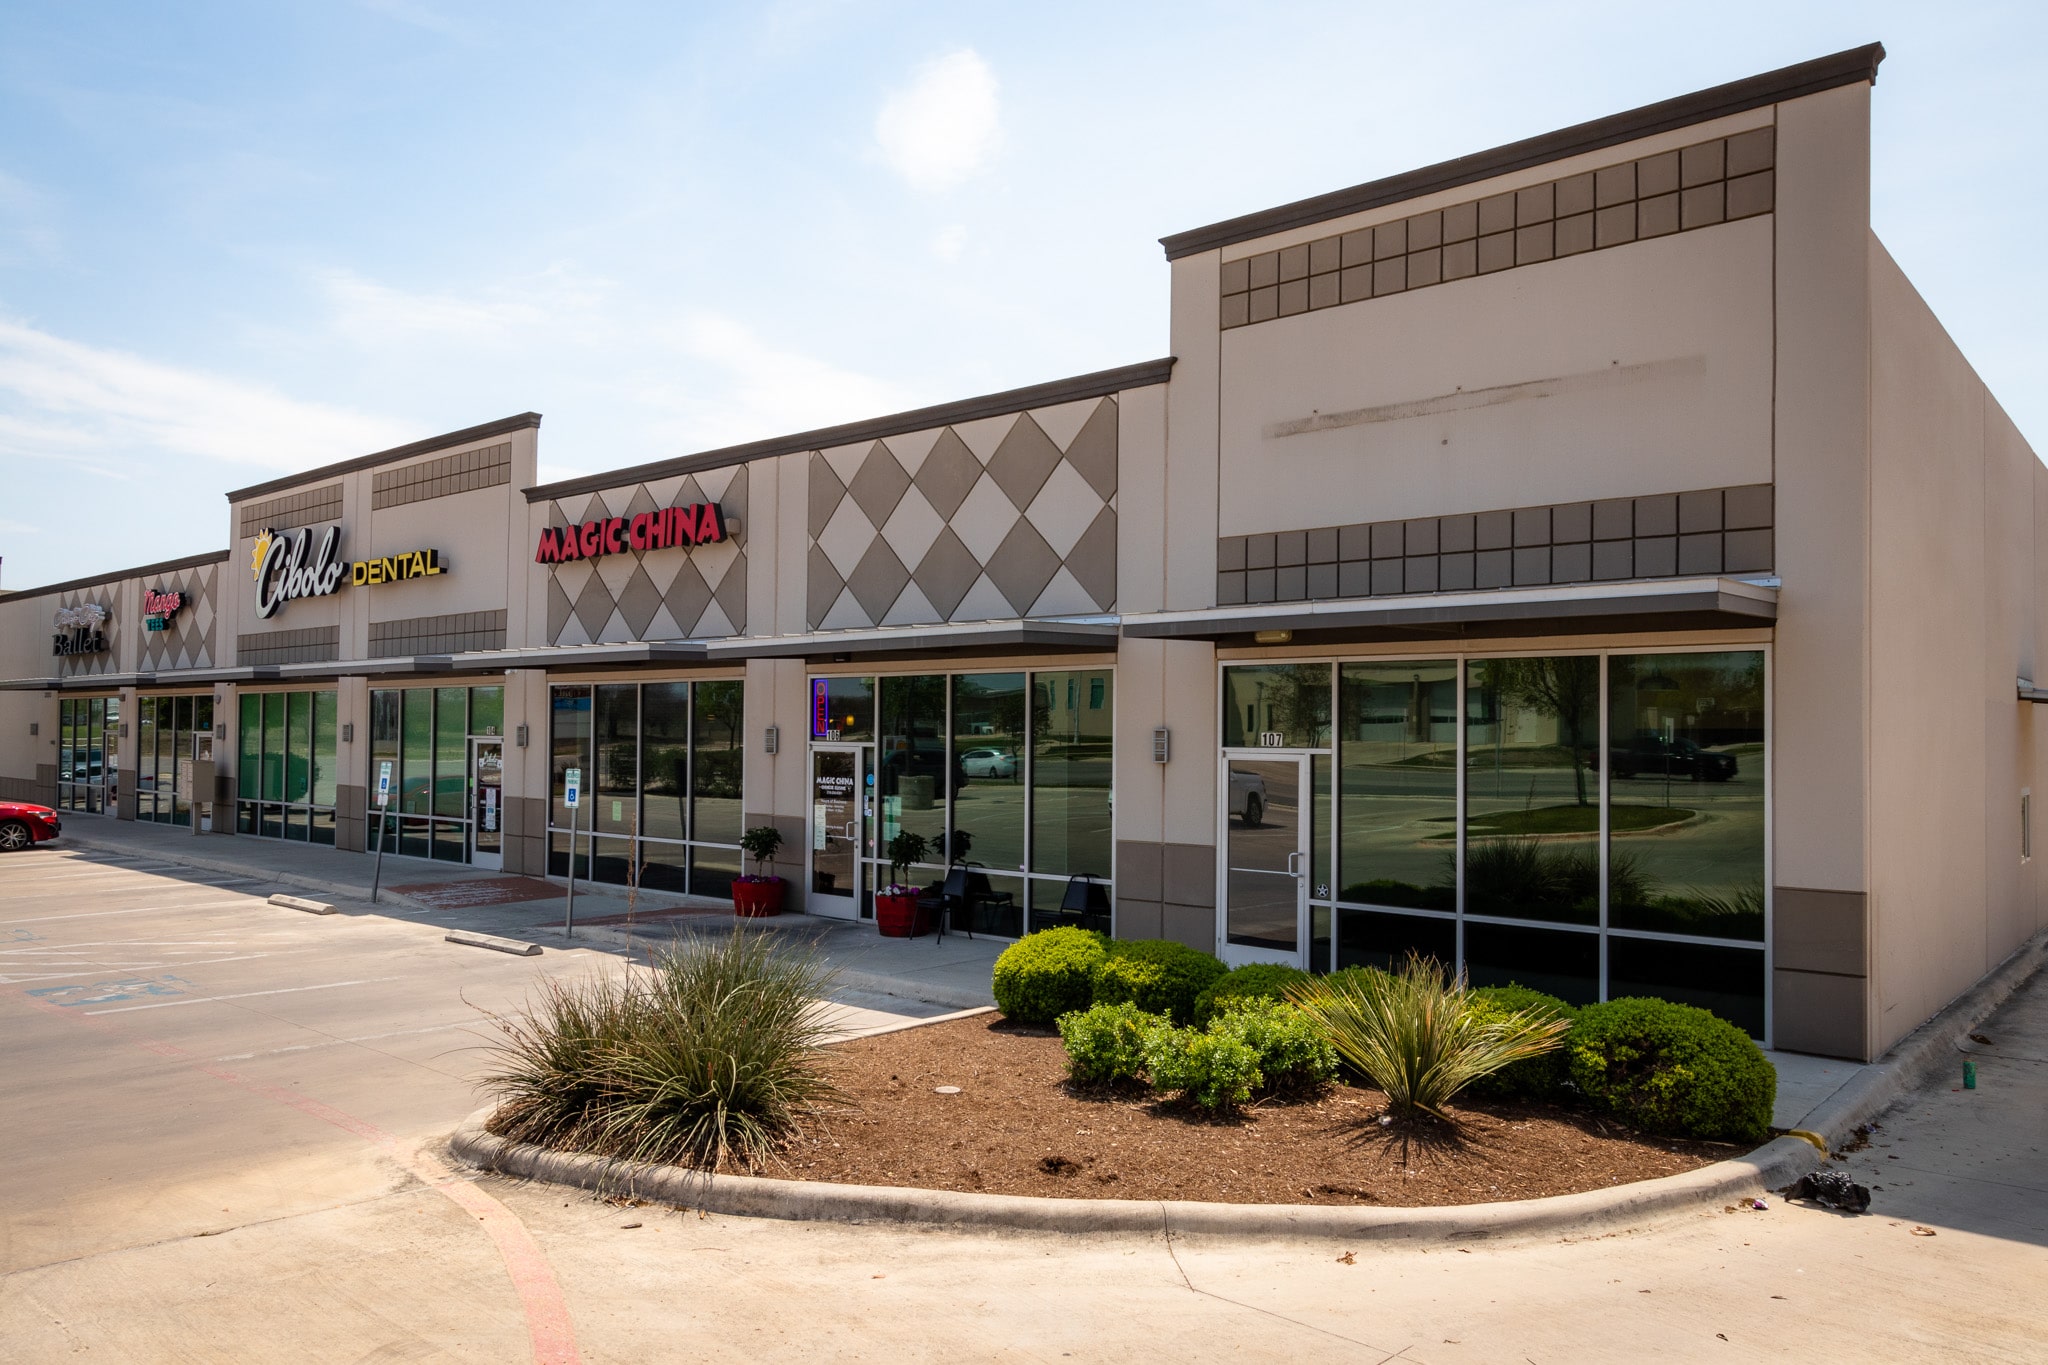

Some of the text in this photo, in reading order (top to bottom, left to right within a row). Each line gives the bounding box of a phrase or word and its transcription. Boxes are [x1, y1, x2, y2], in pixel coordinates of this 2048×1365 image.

[535, 502, 722, 563] MAGIC CHINA
[255, 526, 441, 619] Cibolo DENTAL
[144, 589, 180, 619] Mango
[146, 617, 165, 631] TEES
[53, 627, 102, 656] Ballet
[816, 682, 826, 733] OPEN
[1262, 733, 1282, 746] 107
[816, 776, 854, 785] MAGIC CHINA
